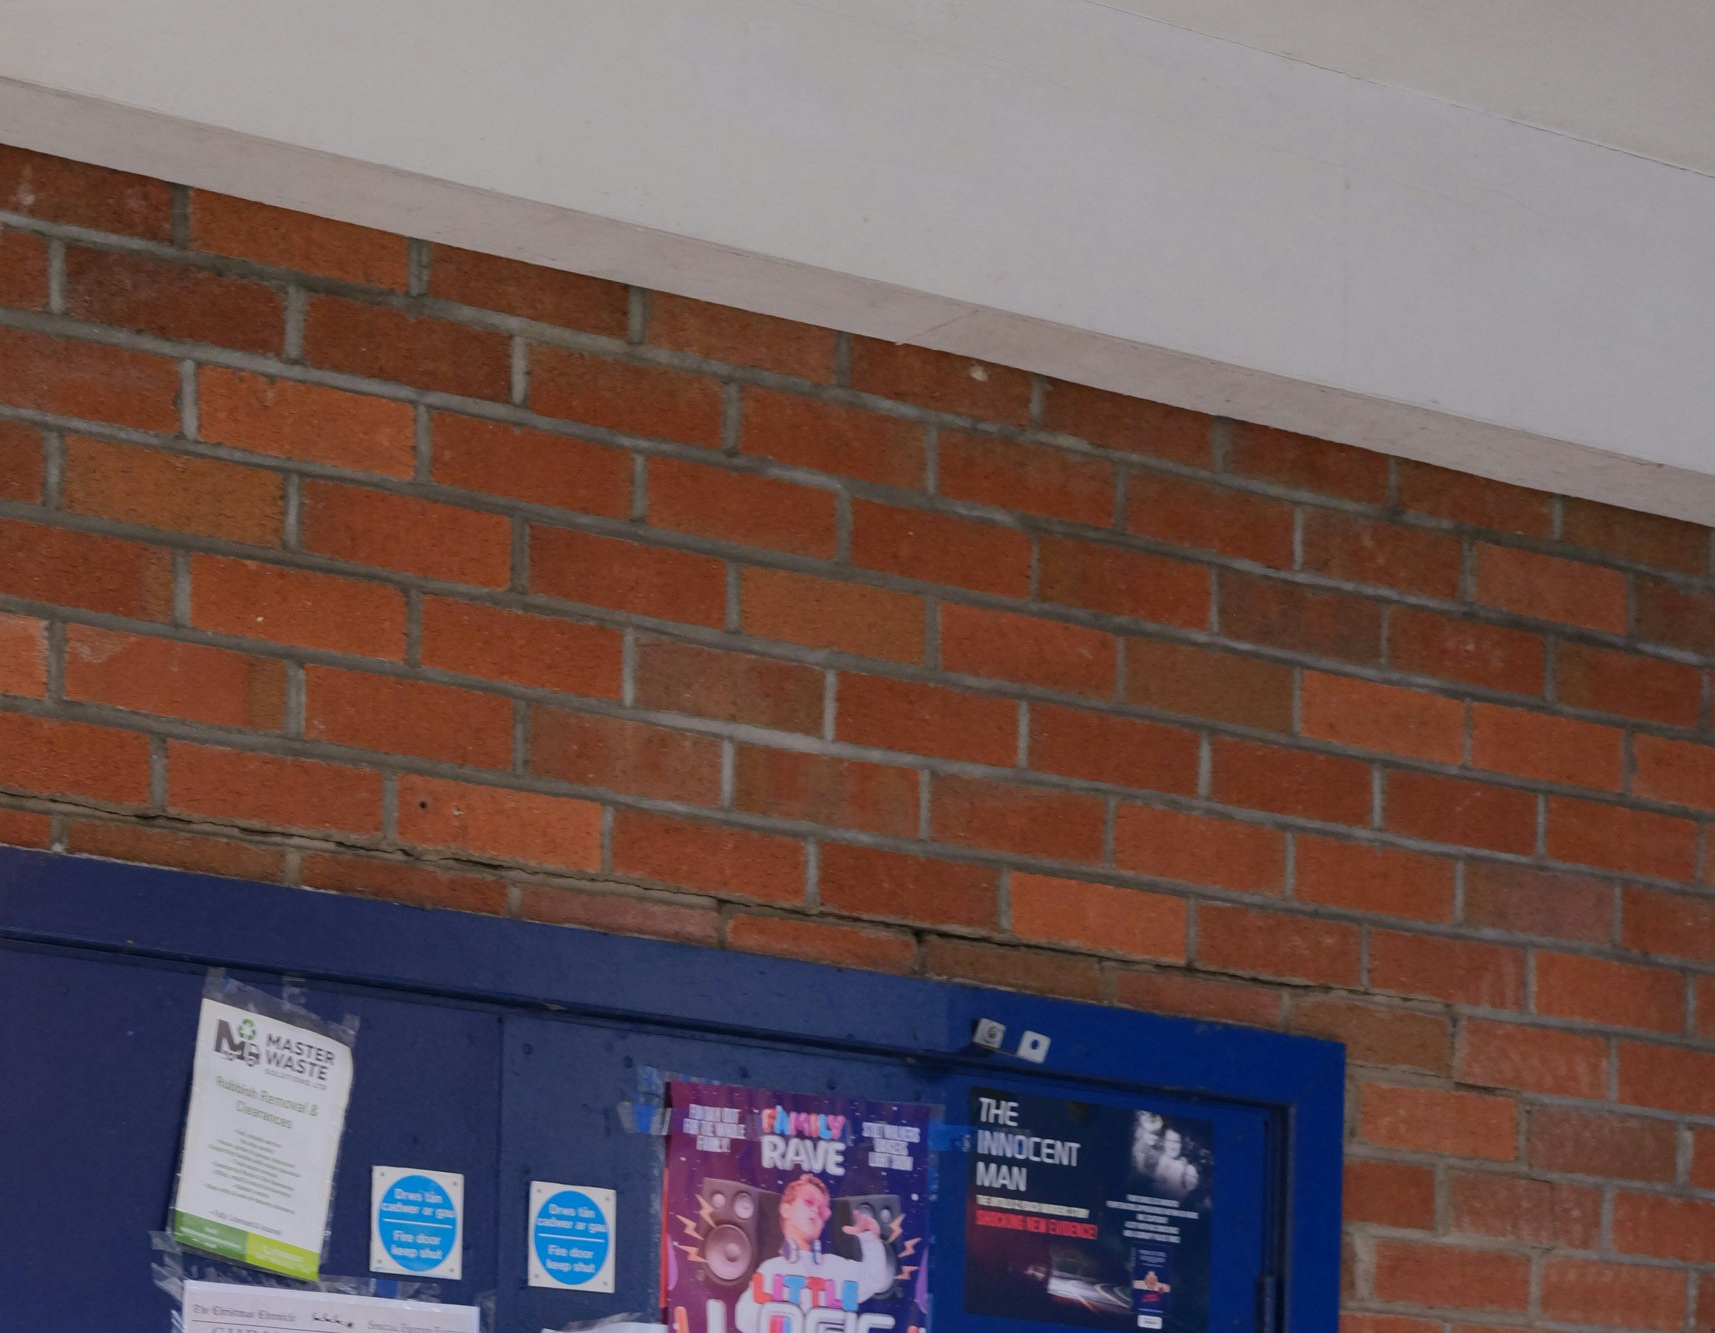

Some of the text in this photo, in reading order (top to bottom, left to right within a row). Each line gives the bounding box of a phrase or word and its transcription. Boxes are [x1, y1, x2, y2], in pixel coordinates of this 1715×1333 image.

[265, 1033, 336, 1065] MASTER
[265, 1049, 328, 1081] WASTE
[761, 1105, 846, 1139] FAMILY
[979, 1097, 1019, 1126] THE
[761, 1135, 846, 1175] RAVE
[977, 1130, 1081, 1166] INNOCENT
[976, 1162, 1027, 1191] MAN
[394, 1188, 422, 1200] Drws
[422, 1207, 433, 1216] ar
[435, 1207, 455, 1219] gau
[548, 1204, 576, 1216] Drws
[393, 1230, 442, 1245] Fire door
[575, 1221, 586, 1230] ar
[588, 1223, 608, 1233] gau
[391, 1245, 443, 1259] keep shut
[548, 1245, 594, 1259] Fire door
[546, 1260, 596, 1273] keep shut
[752, 1272, 858, 1311] LITTLE
